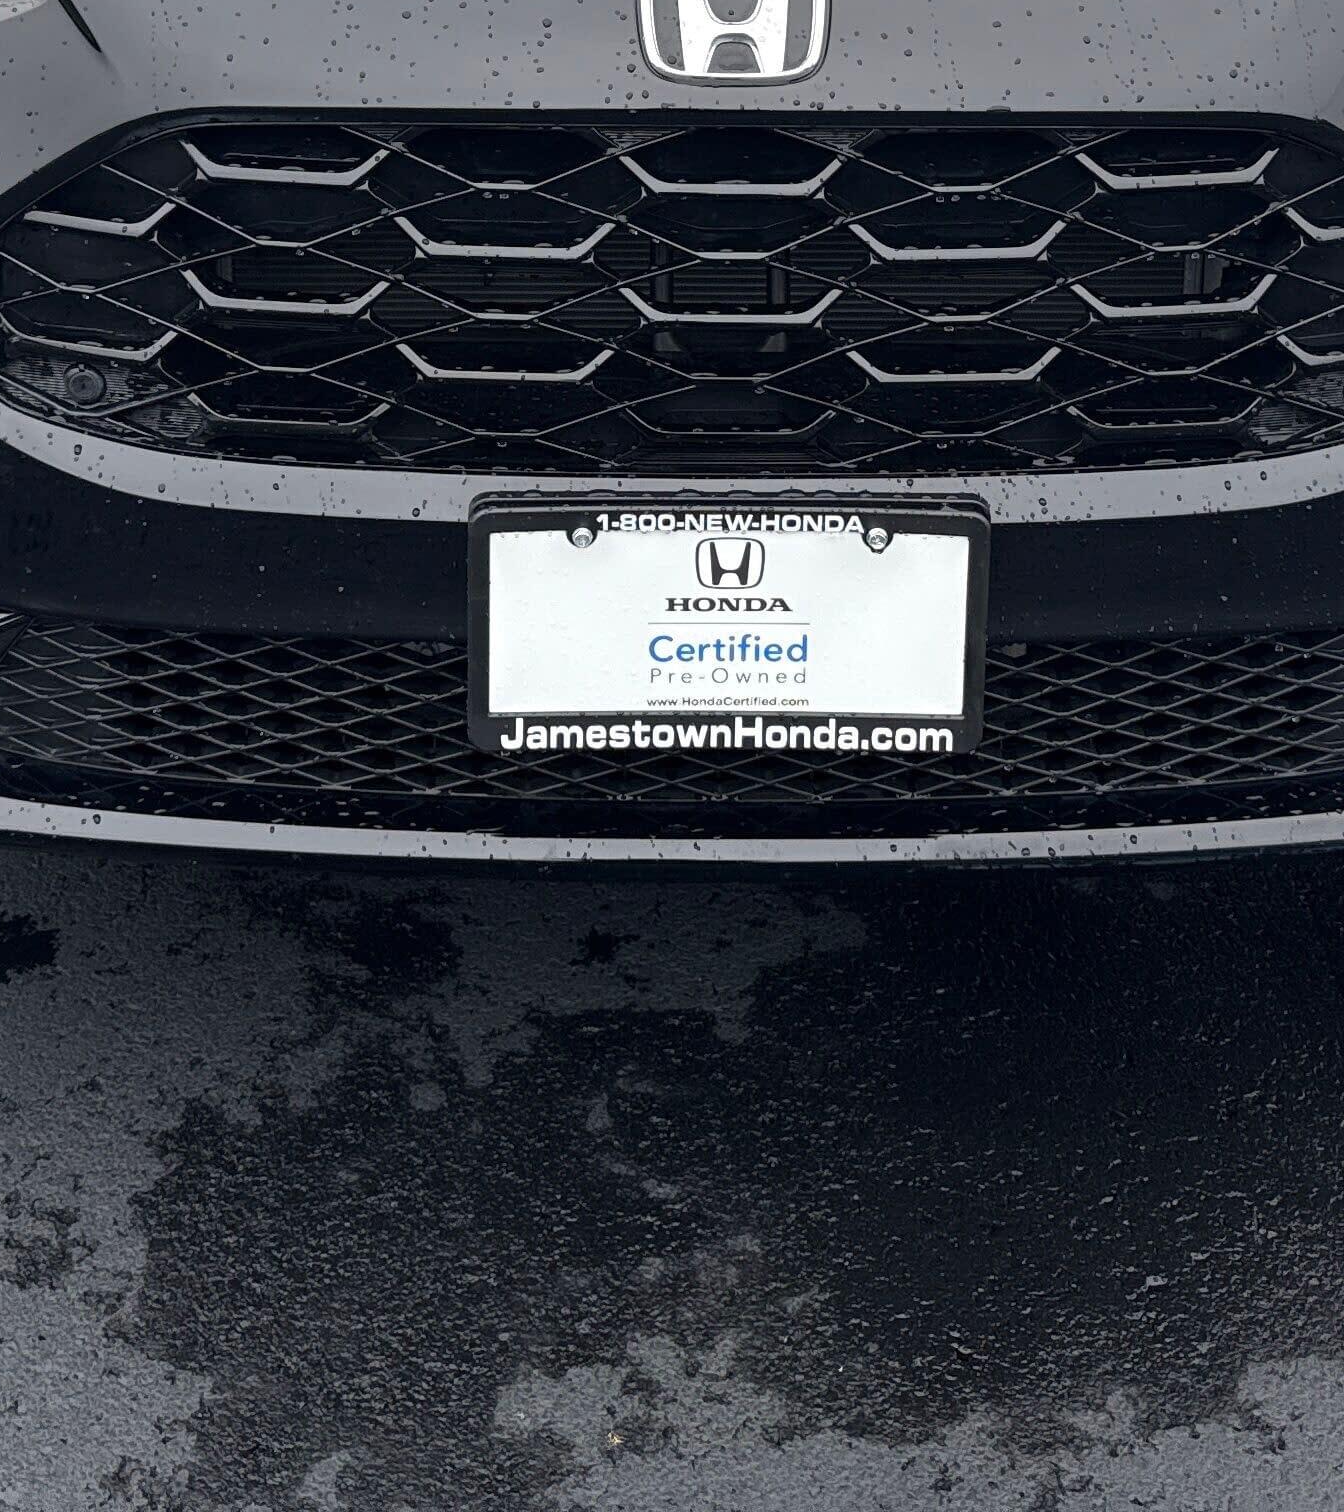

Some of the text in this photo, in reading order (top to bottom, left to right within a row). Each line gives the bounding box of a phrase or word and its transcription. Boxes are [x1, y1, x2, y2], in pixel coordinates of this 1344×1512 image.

[596, 514, 865, 533] 1-800-NEW-HONDA
[664, 597, 792, 612] HONDA
[649, 634, 808, 663] Certified
[650, 667, 808, 684] Pre-Owned
[647, 696, 809, 707] www.HondaCertified.com
[500, 717, 953, 751] JamestownHonda.com
